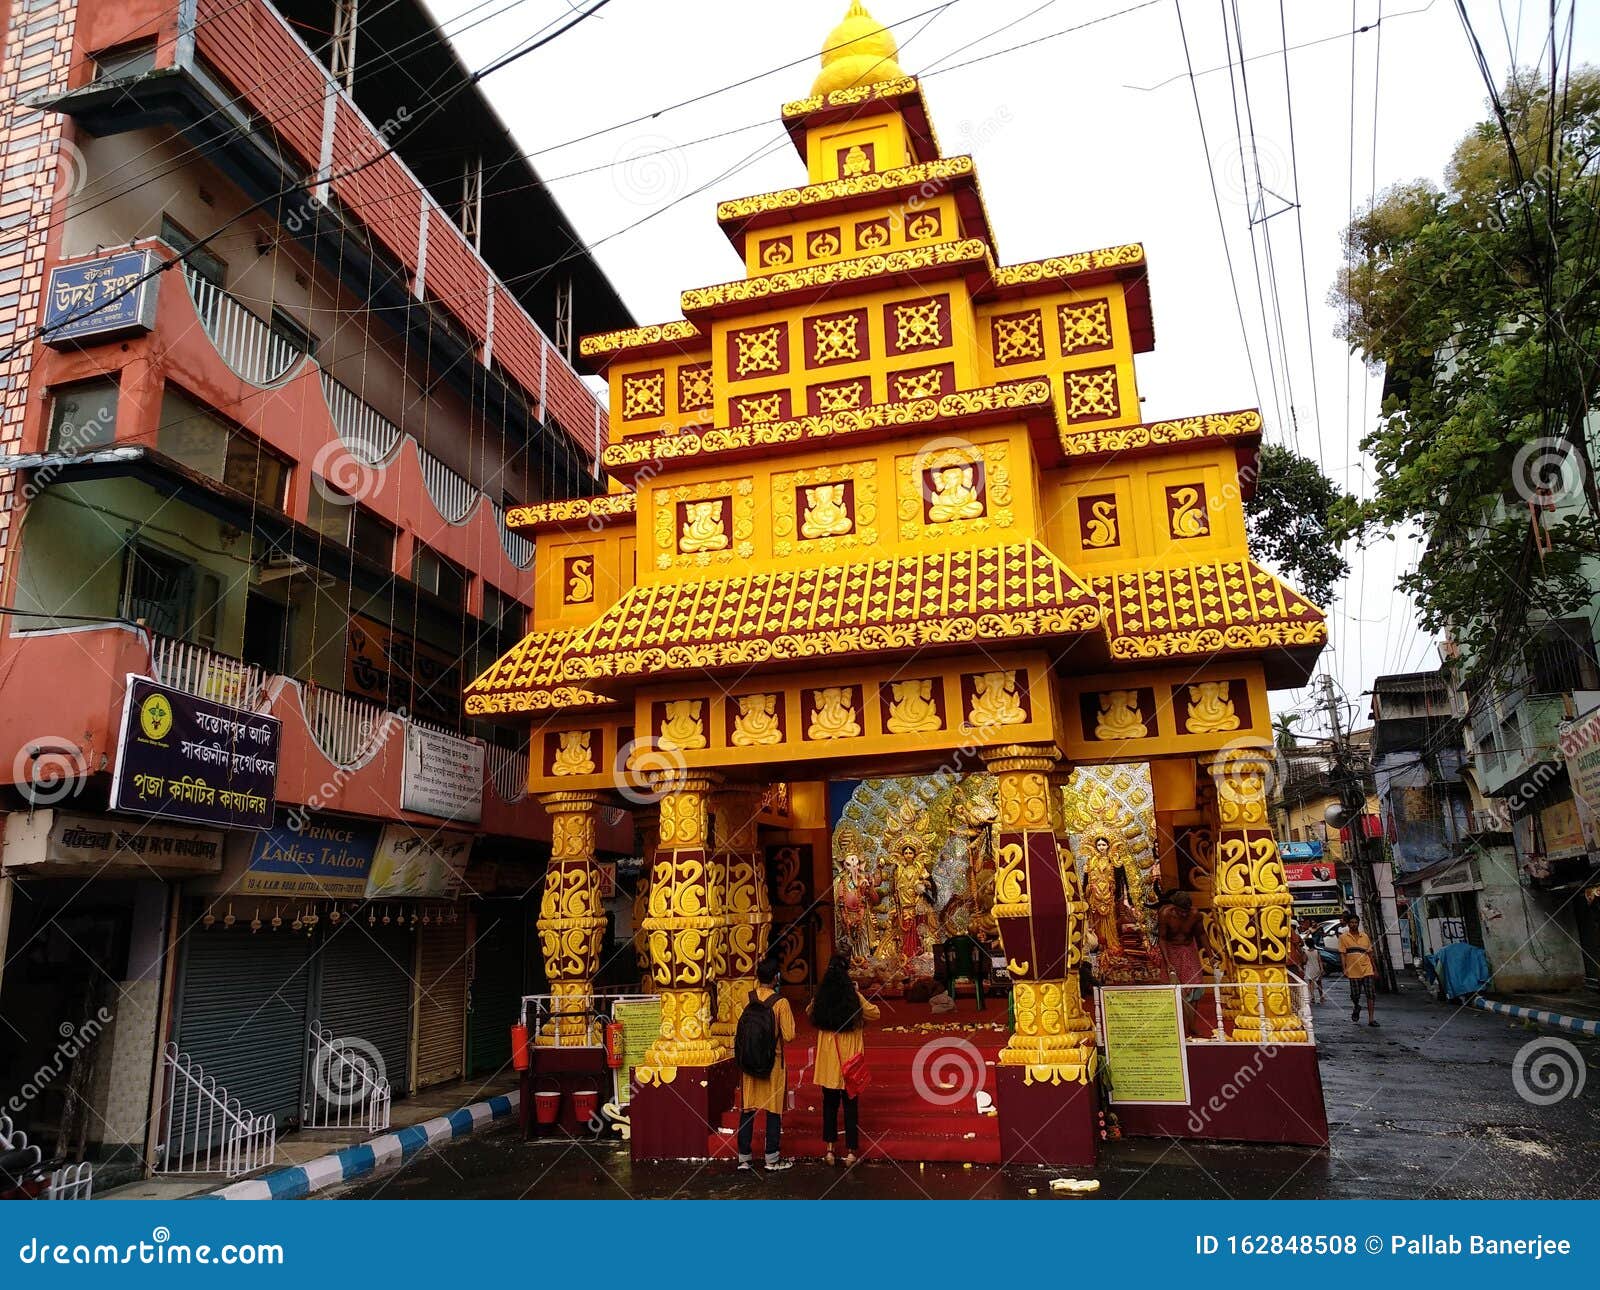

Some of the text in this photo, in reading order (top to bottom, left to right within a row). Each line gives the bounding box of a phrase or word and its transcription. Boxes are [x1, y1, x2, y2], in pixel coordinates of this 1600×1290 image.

[55, 282, 98, 312] উদয়
[196, 711, 246, 743] সন্তোষপুর
[249, 725, 271, 746] আদি
[181, 739, 229, 768] সার্বজনীন
[232, 751, 276, 777] দুর্গোৎসব
[133, 772, 164, 801] পূজা
[168, 775, 216, 806] কমিটির
